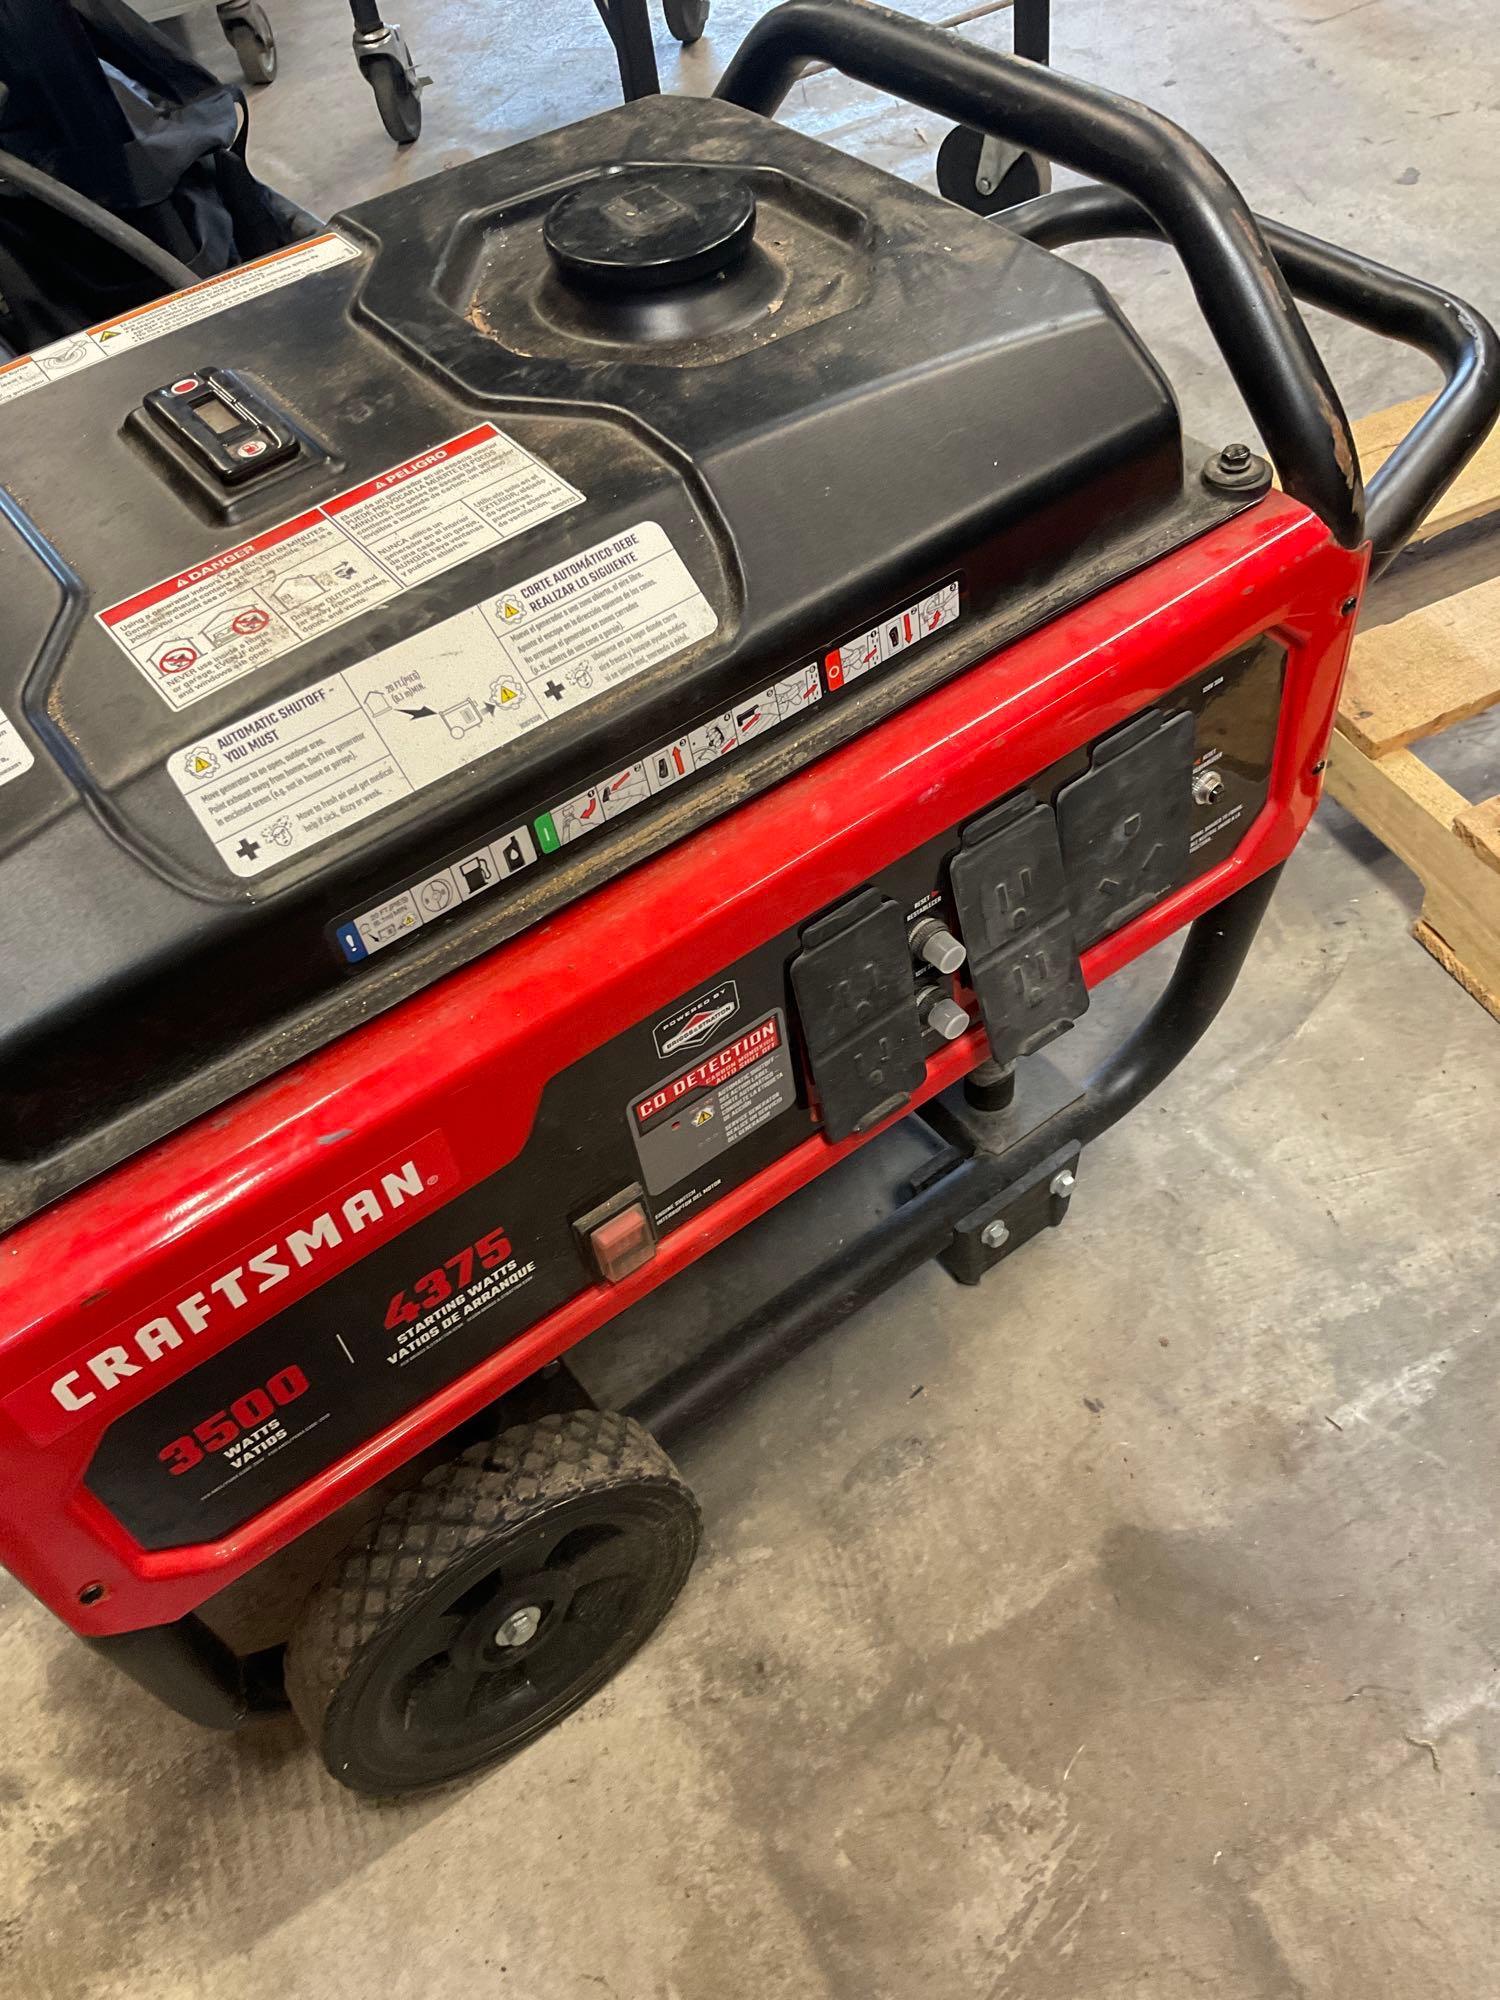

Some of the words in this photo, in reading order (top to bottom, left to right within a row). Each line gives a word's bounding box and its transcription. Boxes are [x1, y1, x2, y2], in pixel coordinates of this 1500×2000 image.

[385, 449, 449, 483] PELIGRO
[345, 510, 373, 526] PUEDE
[371, 489, 415, 513] PROVOCAR
[413, 483, 426, 491] LA
[187, 544, 256, 581] DANGER
[377, 538, 409, 555] NUNCA
[324, 582, 362, 604] OUTSIDE
[520, 576, 553, 599] CORTE
[529, 582, 576, 612] REALIZAR
[574, 575, 589, 588] LO
[587, 550, 637, 582] SIGUIENTE
[118, 616, 143, 632] Using
[166, 667, 197, 687] NEVER
[215, 712, 279, 749] AUTOMATIC
[277, 688, 328, 719] SHUTOFF
[223, 744, 248, 763] YOU
[247, 729, 280, 752] MUST
[906, 896, 942, 922] RESTABLECER
[914, 894, 931, 909] RESET
[662, 997, 710, 1030] POWERED
[712, 988, 725, 999] BY
[639, 1091, 666, 1117] CO
[672, 1021, 774, 1096] DETECTION
[705, 1060, 736, 1084] CARBON
[738, 1036, 774, 1063] MONOXIDE
[716, 1065, 736, 1083] AUTO
[739, 1051, 758, 1069] SHUT
[762, 1041, 775, 1054] OFF
[50, 1160, 426, 1412] CRAFTSMAN
[384, 1226, 512, 1331] 4375
[387, 1326, 439, 1365] VATIOS
[442, 1312, 462, 1330] DE
[464, 1261, 536, 1316] ARRANQUE
[397, 1294, 466, 1344] STARTING
[467, 1260, 517, 1296] WATTS
[158, 1364, 311, 1476] 3500
[223, 1419, 280, 1458] WATTS
[230, 1429, 288, 1468] VATIOS
